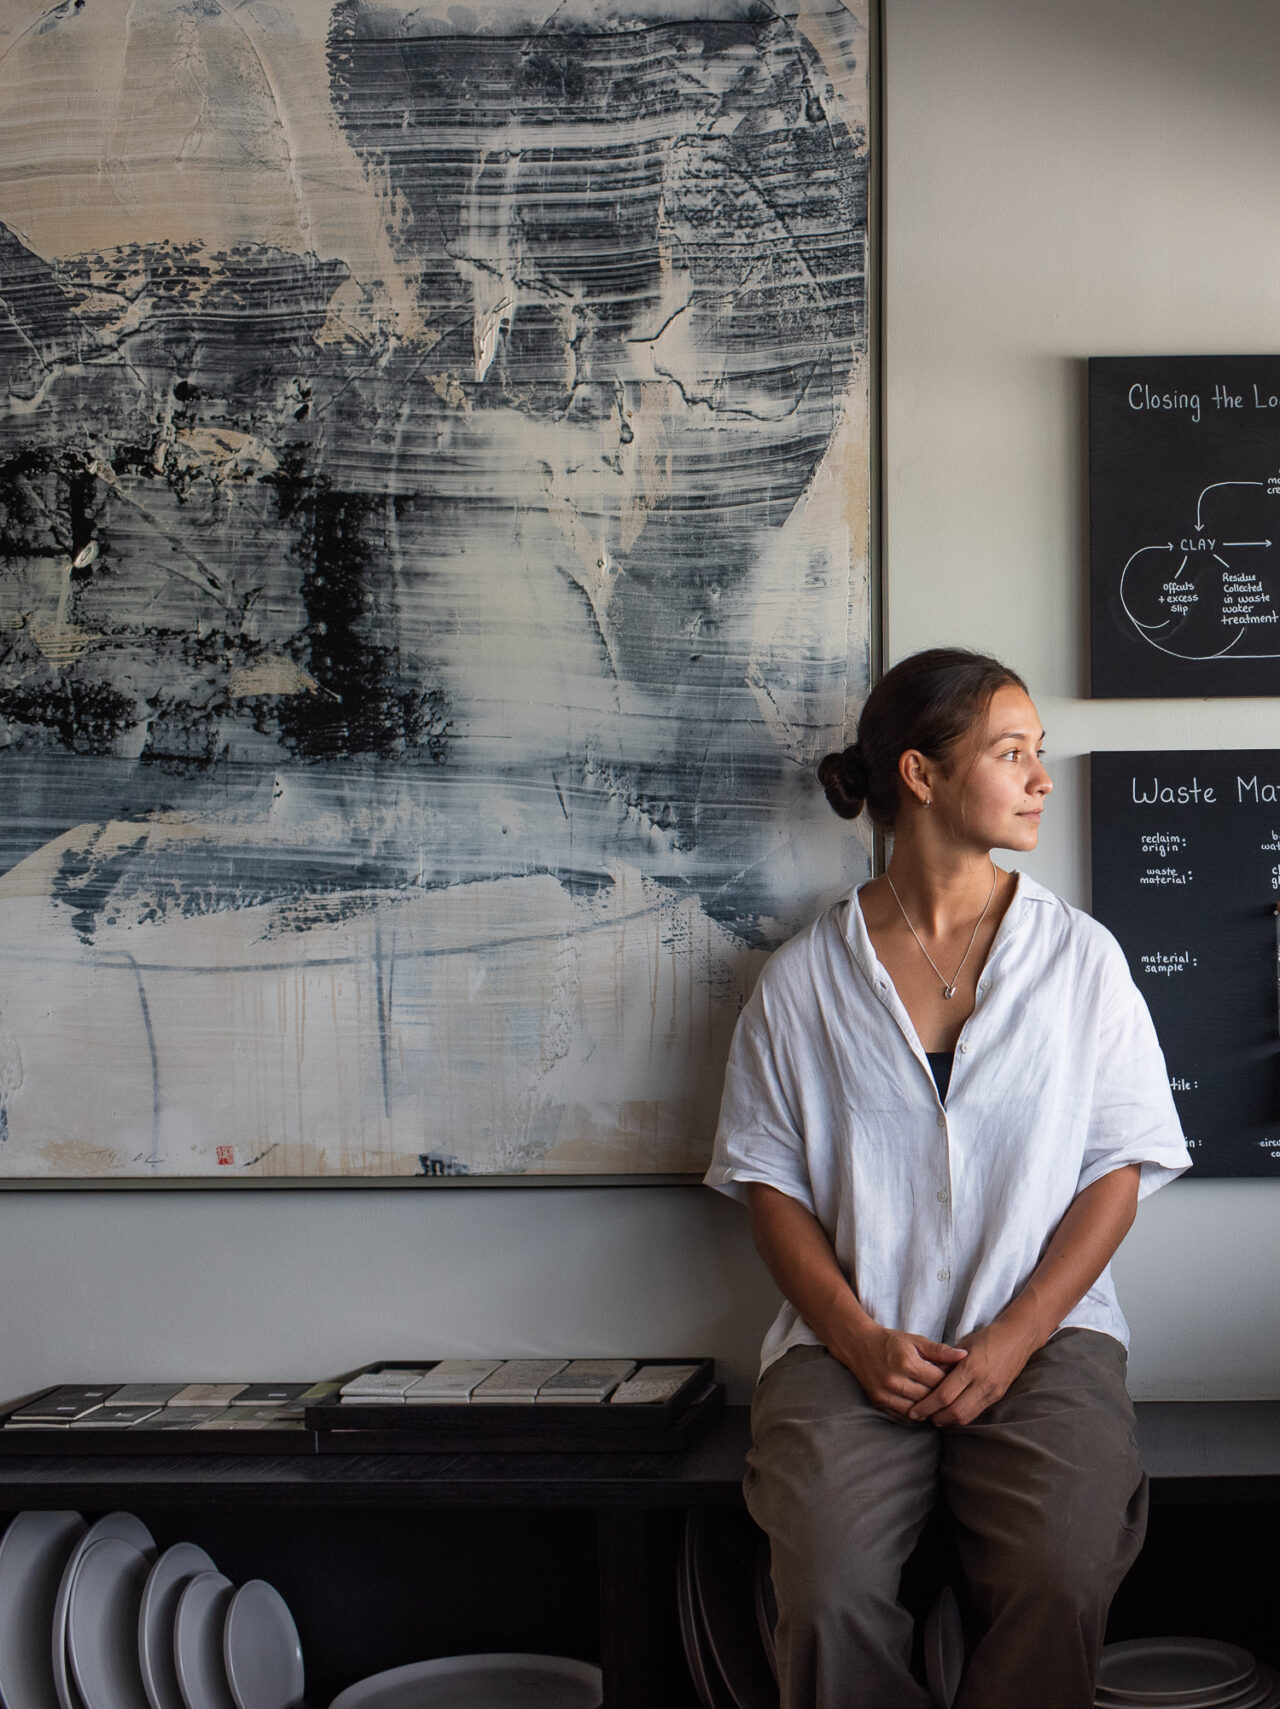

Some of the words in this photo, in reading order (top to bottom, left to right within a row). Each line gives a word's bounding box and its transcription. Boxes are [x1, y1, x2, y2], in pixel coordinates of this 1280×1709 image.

[1128, 383, 1201, 423] Closing
[1212, 385, 1243, 409] the
[1180, 539, 1216, 551] CLAY
[1222, 573, 1256, 582] Residue
[1166, 593, 1199, 603] excess
[1224, 594, 1233, 603] in
[1237, 594, 1270, 603] waste
[1222, 605, 1254, 614] water
[1221, 611, 1279, 625] treatment
[1132, 777, 1217, 804] Waste
[1146, 867, 1178, 876] waste
